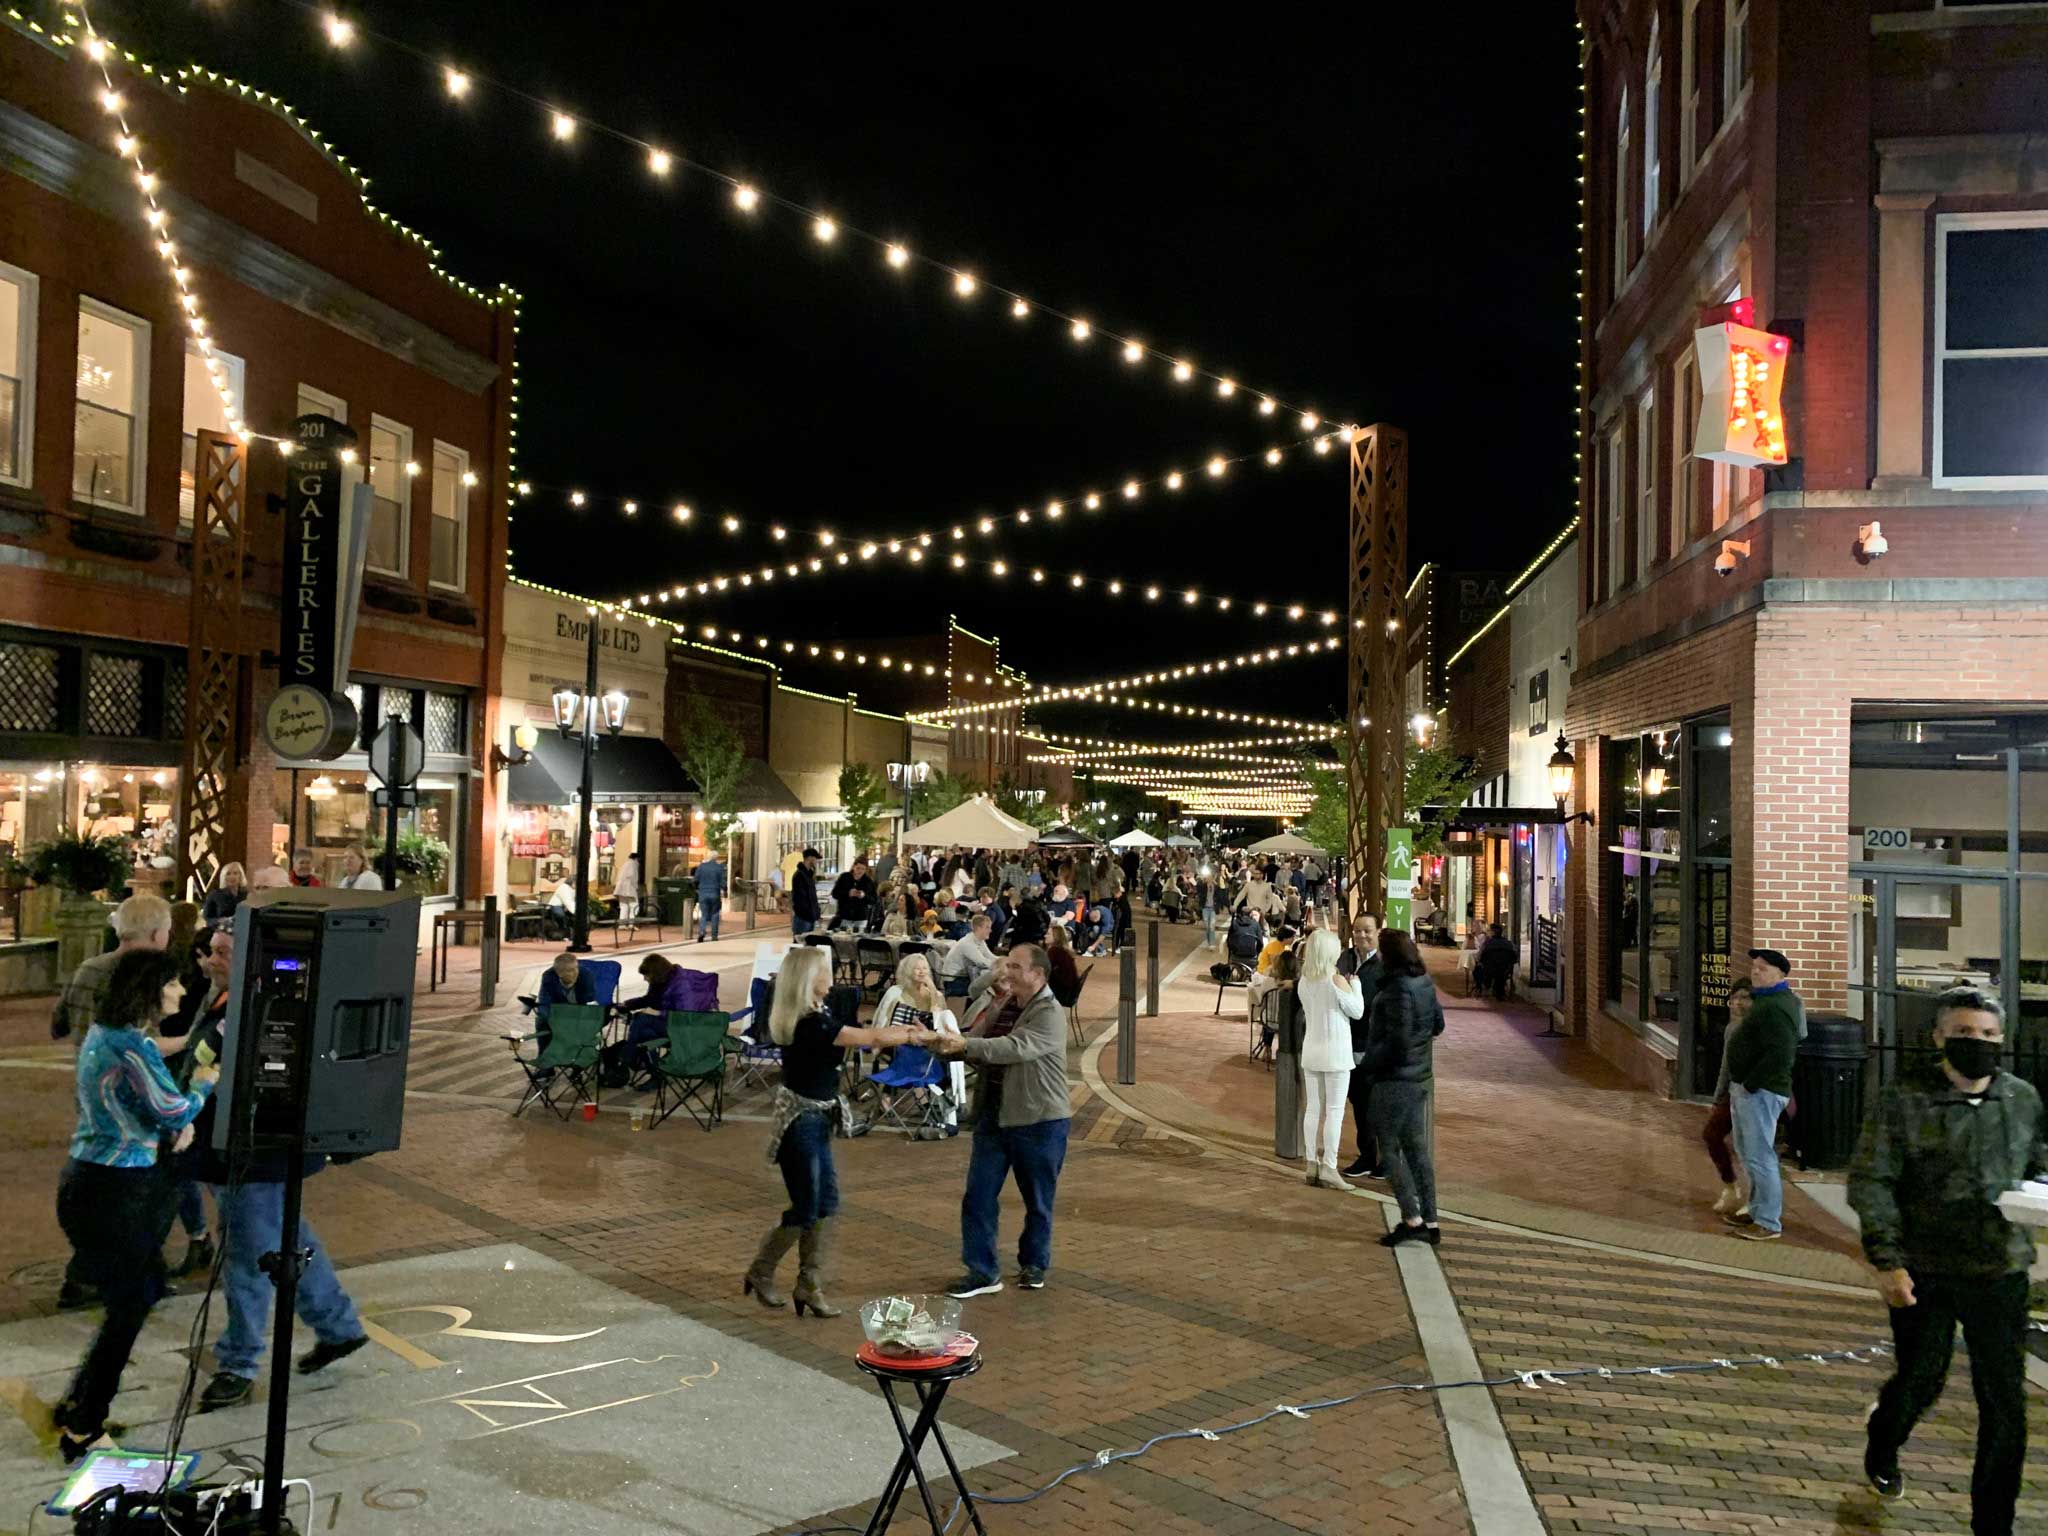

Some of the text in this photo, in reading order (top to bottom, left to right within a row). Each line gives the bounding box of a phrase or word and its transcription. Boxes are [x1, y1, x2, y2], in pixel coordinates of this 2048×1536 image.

[300, 423, 325, 438] 201
[299, 461, 328, 470] THE
[296, 475, 323, 676] GALLERIES
[556, 614, 641, 653] EMPE LTD
[1867, 829, 1908, 847] 200
[1849, 894, 1877, 904] IORS
[1701, 953, 1731, 964] KITCH
[1701, 975, 1731, 986] CUSTO
[1701, 985, 1732, 996] HARD
[1701, 996, 1725, 1007] FREE
